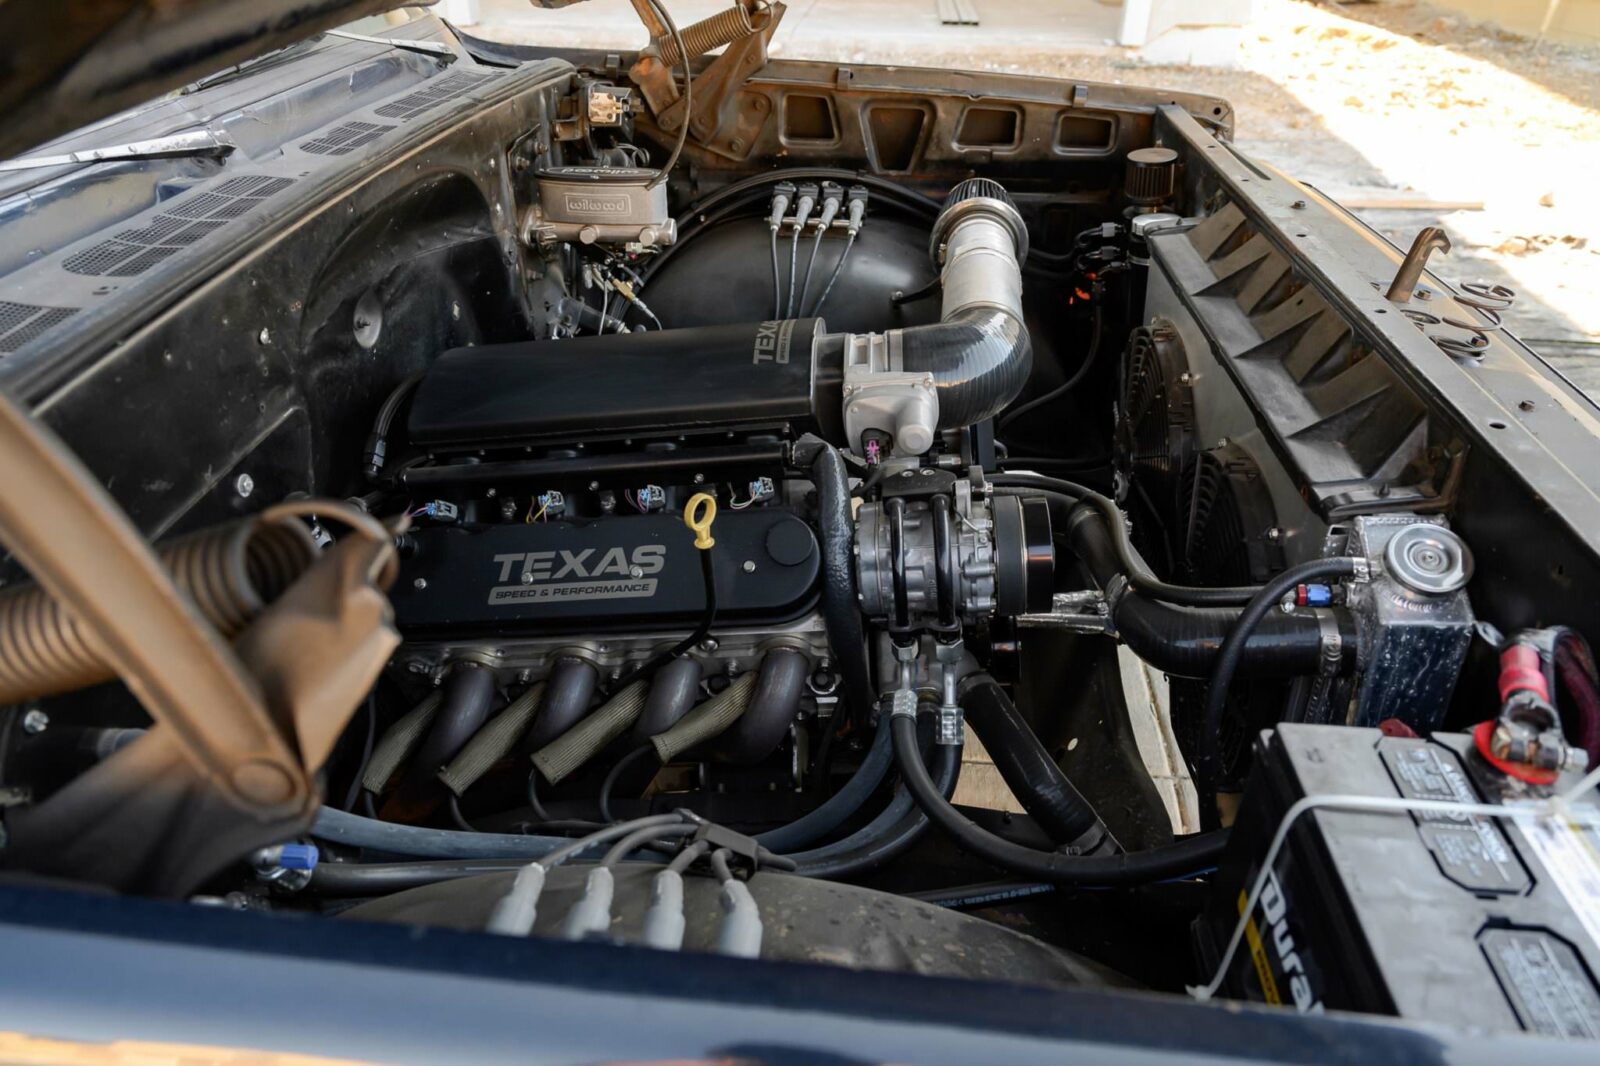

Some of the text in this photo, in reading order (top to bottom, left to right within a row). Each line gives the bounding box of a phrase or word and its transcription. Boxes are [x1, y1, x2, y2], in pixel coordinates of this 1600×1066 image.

[569, 199, 624, 211] wilwood
[493, 544, 666, 582] TEXAS
[495, 583, 650, 599] SPEED & PERFORMANCE
